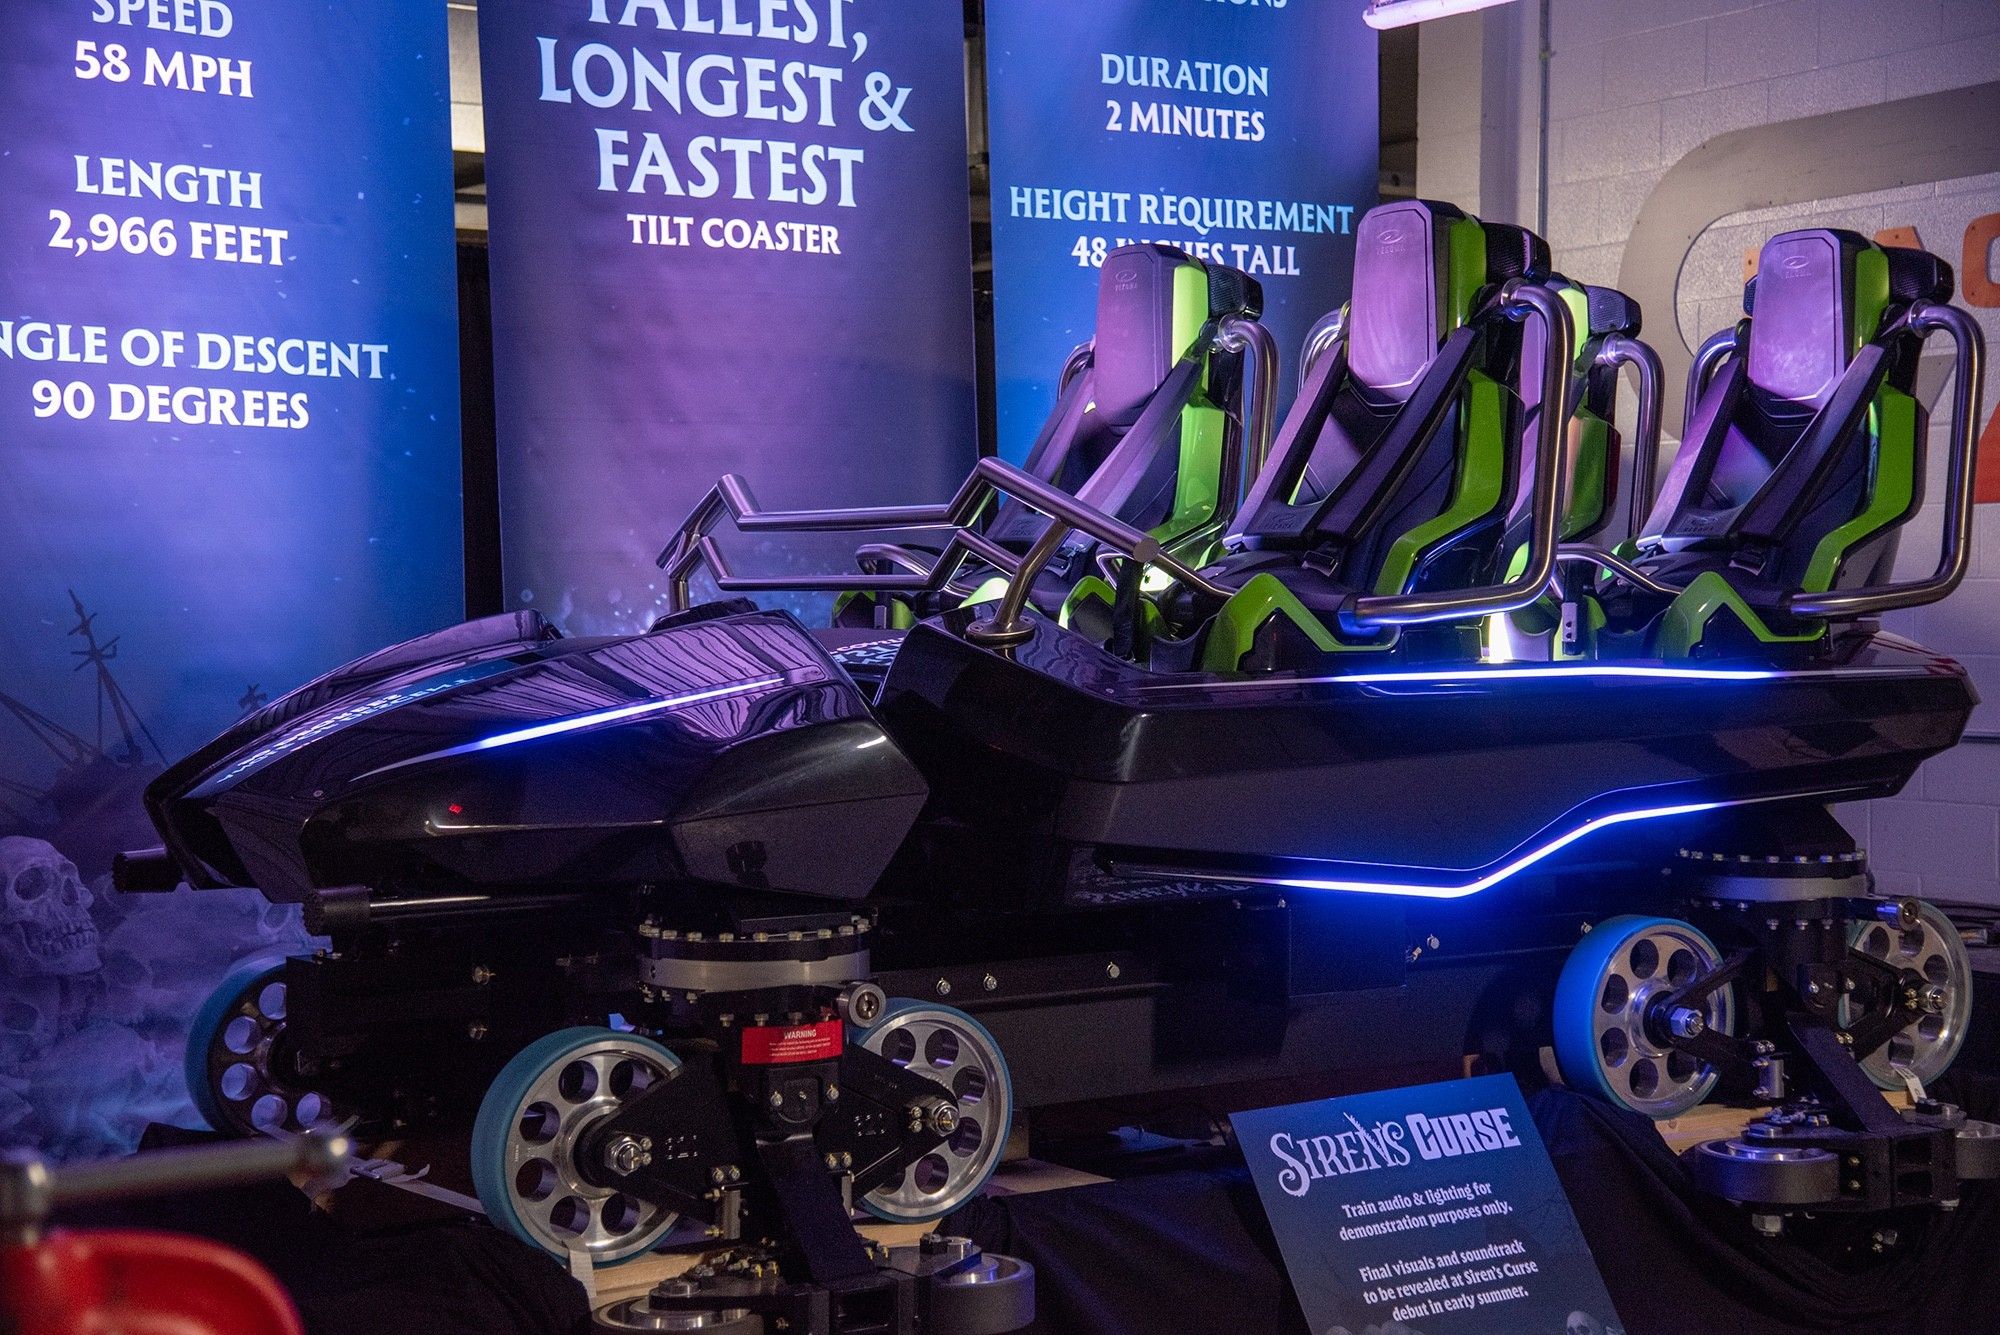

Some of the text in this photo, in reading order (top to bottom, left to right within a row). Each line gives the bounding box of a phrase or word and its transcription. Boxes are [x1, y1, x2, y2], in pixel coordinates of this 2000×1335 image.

[92, 0, 233, 38] SPEED
[74, 40, 254, 98] 58 MPH
[536, 37, 915, 132] LONGEST &
[1101, 53, 1268, 96] DURATION
[1106, 100, 1265, 142] 2 MINUTES
[74, 155, 263, 209] LENGTH
[594, 128, 864, 207] FASTEST
[1010, 186, 1354, 235] HEIGHT REQUIREMENT
[48, 209, 288, 266] 2,966 FEET
[627, 214, 841, 255] TILT COASTER
[1071, 236, 1107, 268] 48
[1231, 244, 1300, 275] TALL
[121, 328, 184, 368] OF
[196, 332, 389, 379] DESCENT
[32, 380, 309, 429] 90 DEGREES
[783, 1029, 817, 1040] WARNING
[1406, 1107, 1521, 1161] CURSE
[1339, 1200, 1513, 1242] demonstration purposes only.
[1341, 1181, 1492, 1218] Train audio & lighting for
[1359, 1239, 1527, 1282] Final visuals and soundtrack
[1363, 1260, 1539, 1305] to be revealed at Siren's Curse
[1392, 1286, 1529, 1322] debut in early summer.
